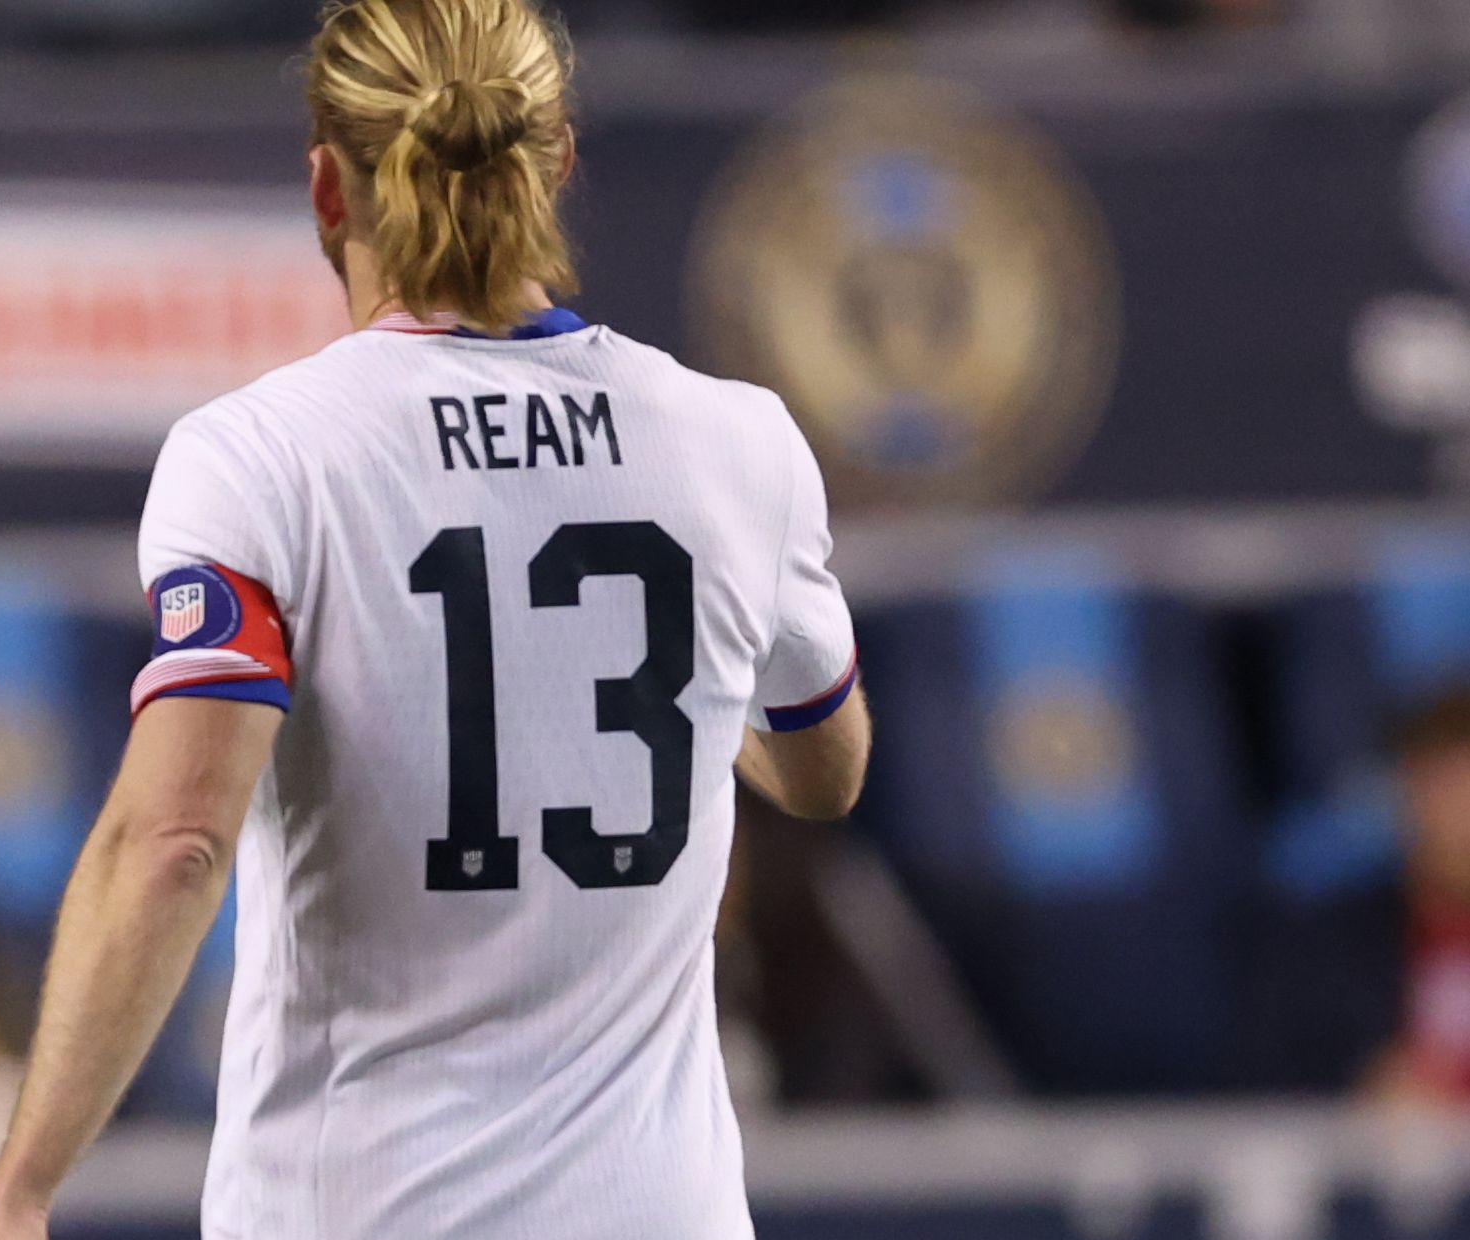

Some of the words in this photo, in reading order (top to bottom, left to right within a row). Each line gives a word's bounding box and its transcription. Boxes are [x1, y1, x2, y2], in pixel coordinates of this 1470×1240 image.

[429, 391, 623, 470] REAM
[163, 588, 199, 611] USA
[408, 520, 694, 891] 13
